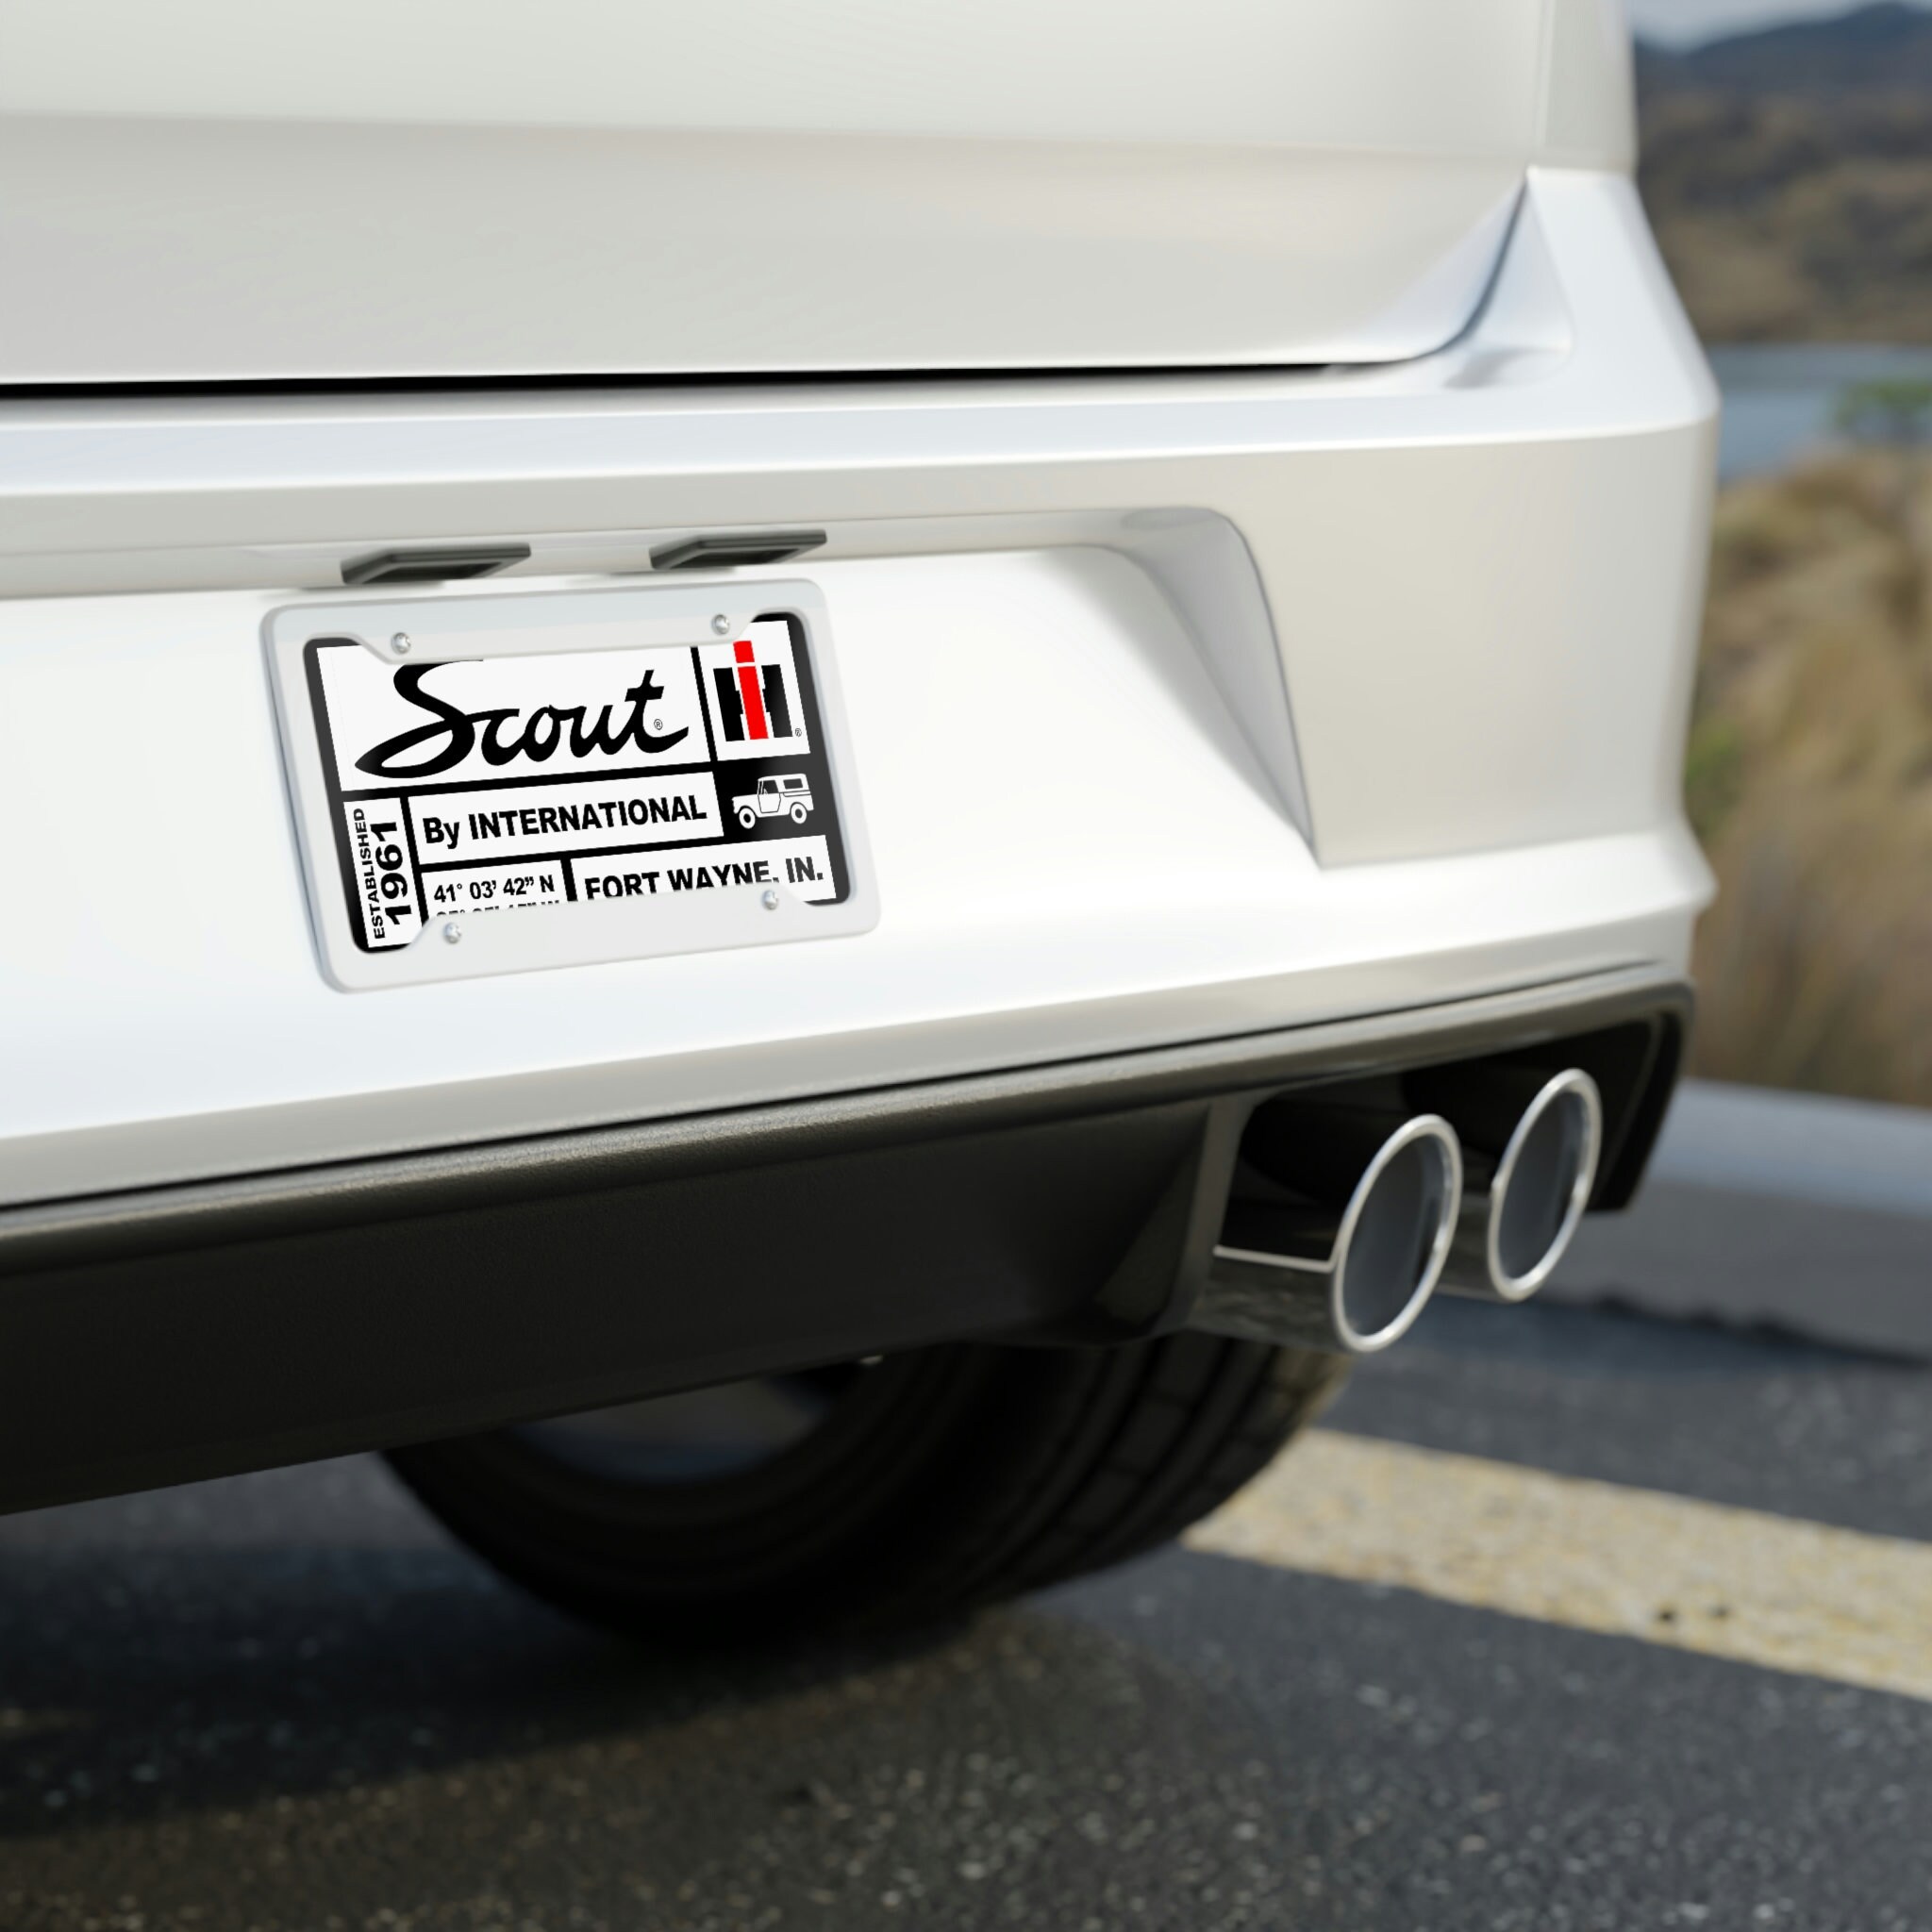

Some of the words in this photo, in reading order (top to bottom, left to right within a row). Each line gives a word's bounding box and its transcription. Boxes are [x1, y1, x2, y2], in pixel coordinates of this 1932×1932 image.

[423, 817, 459, 849] By
[468, 795, 707, 840] INTERNATIONAL
[353, 808, 385, 939] ESTABLISHED
[370, 822, 412, 925] 1961
[540, 874, 555, 892] N
[585, 872, 659, 900] FORT
[785, 857, 824, 883] IN.
